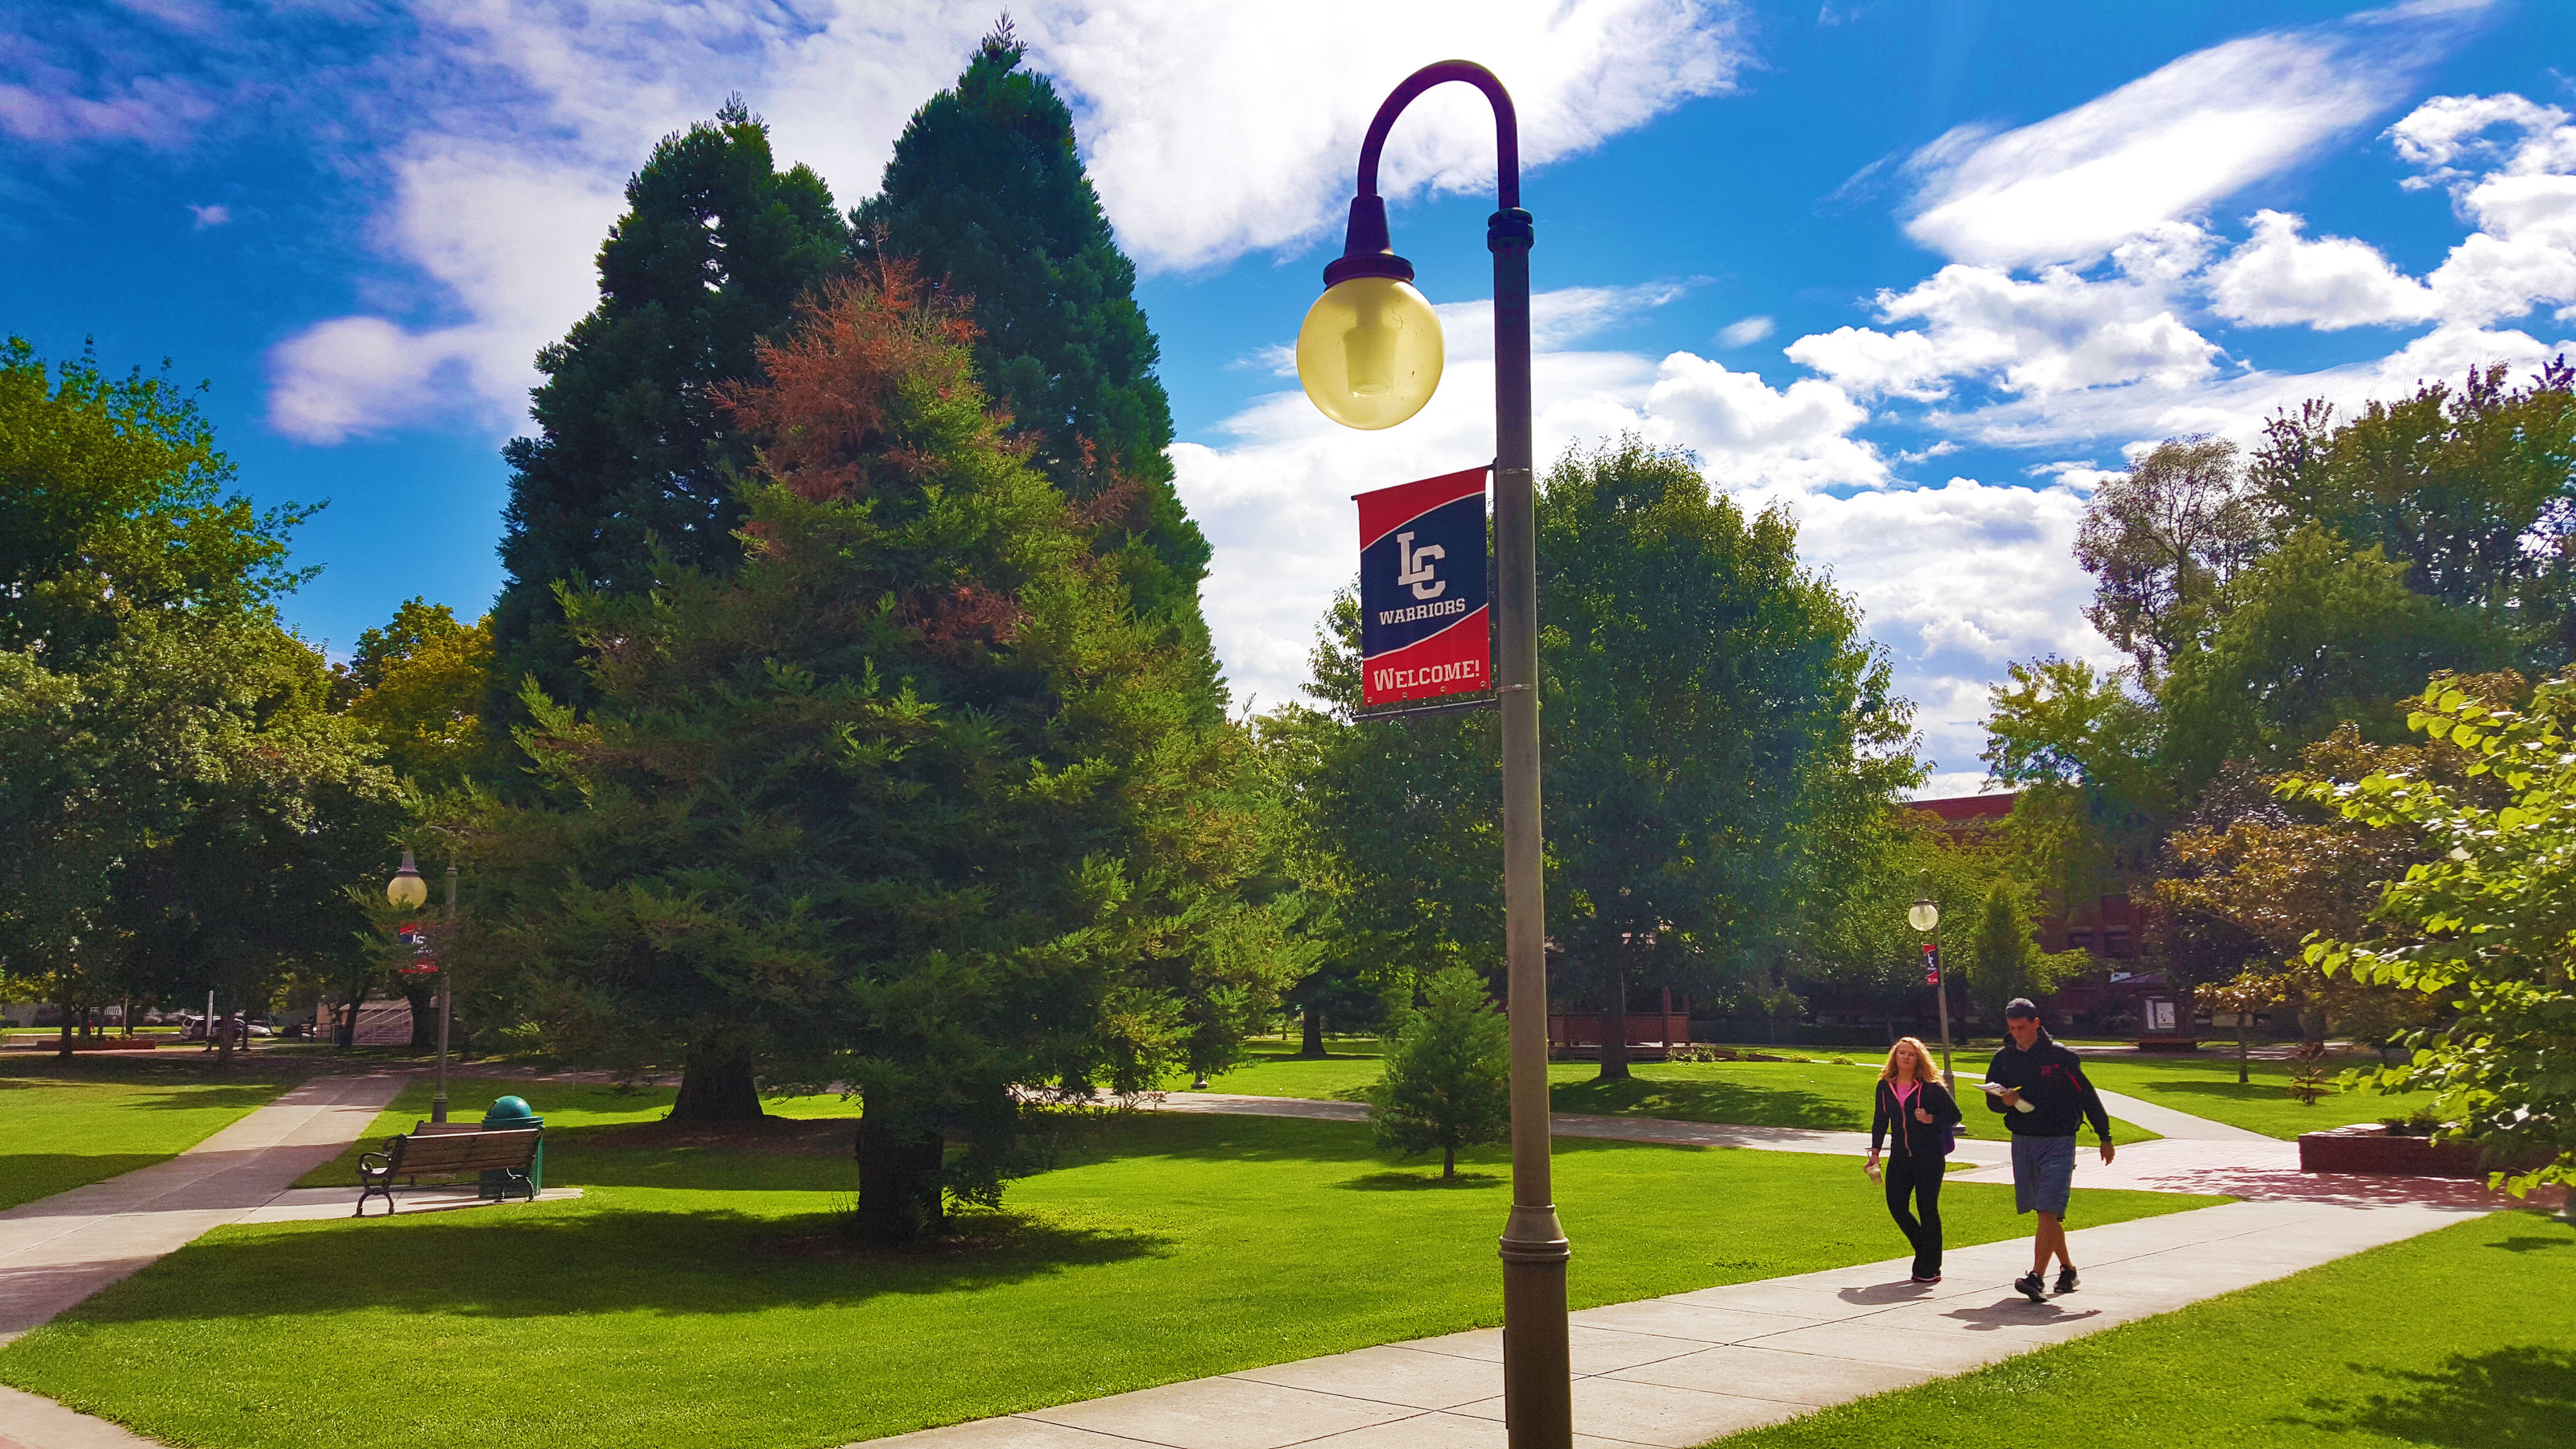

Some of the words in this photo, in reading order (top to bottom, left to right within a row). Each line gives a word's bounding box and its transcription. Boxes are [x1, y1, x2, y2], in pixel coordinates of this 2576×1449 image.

[1397, 531, 1446, 600] LC
[1379, 598, 1466, 625] WARRIORS
[1373, 659, 1480, 691] WELCOME!
